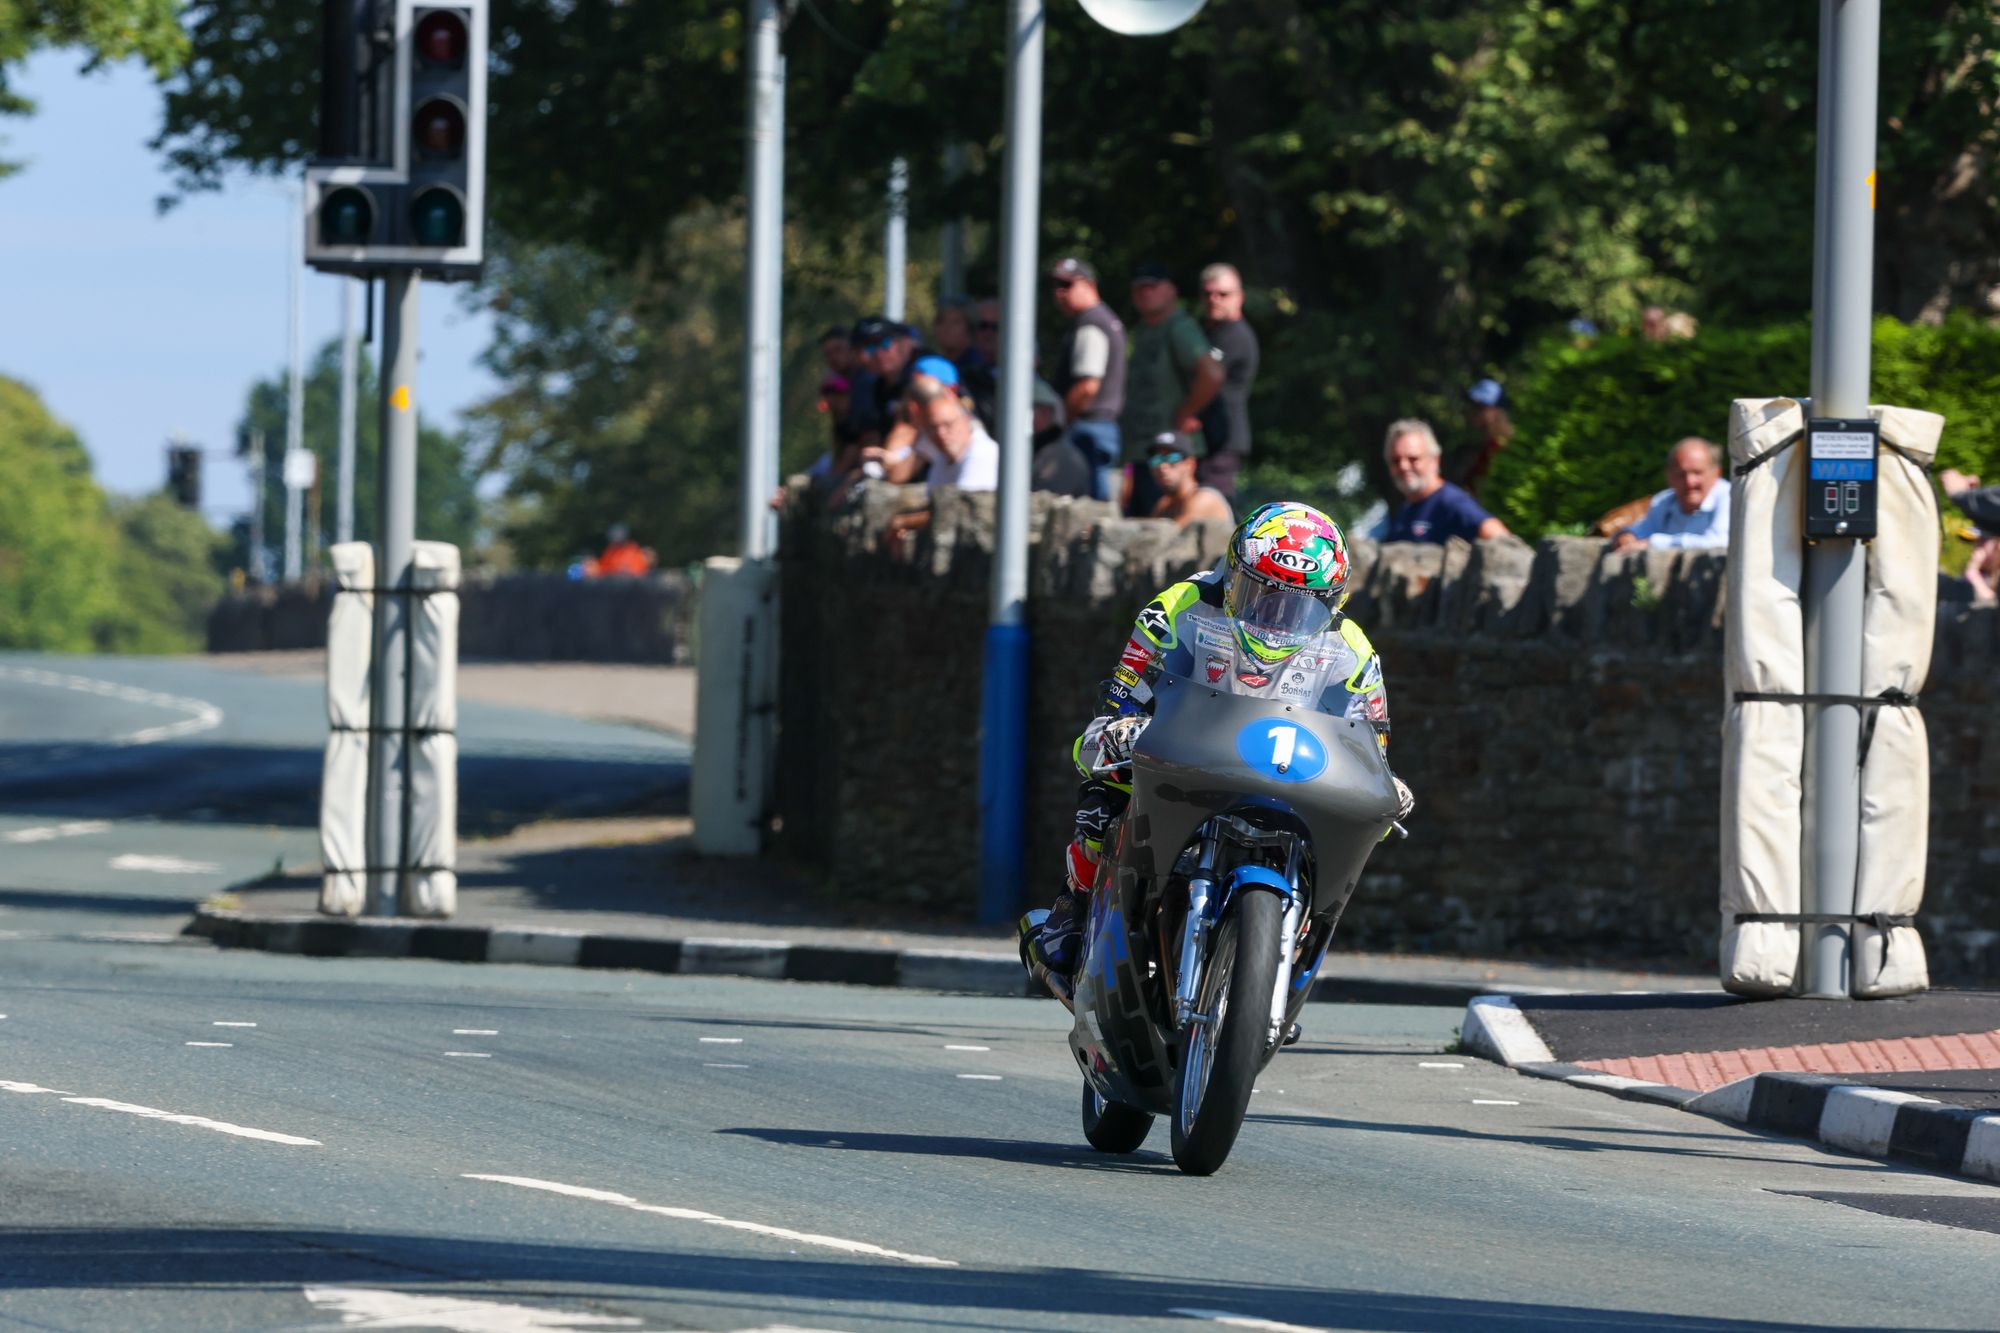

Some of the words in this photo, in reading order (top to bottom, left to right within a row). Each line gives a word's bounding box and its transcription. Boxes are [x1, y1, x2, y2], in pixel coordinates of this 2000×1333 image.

[1816, 463, 1867, 480] WAIT
[1274, 551, 1313, 571] KYT
[1278, 583, 1316, 597] Bennetts
[1291, 654, 1335, 673] KYT
[1118, 666, 1137, 683] RDAHL
[1267, 725, 1297, 765] 1
